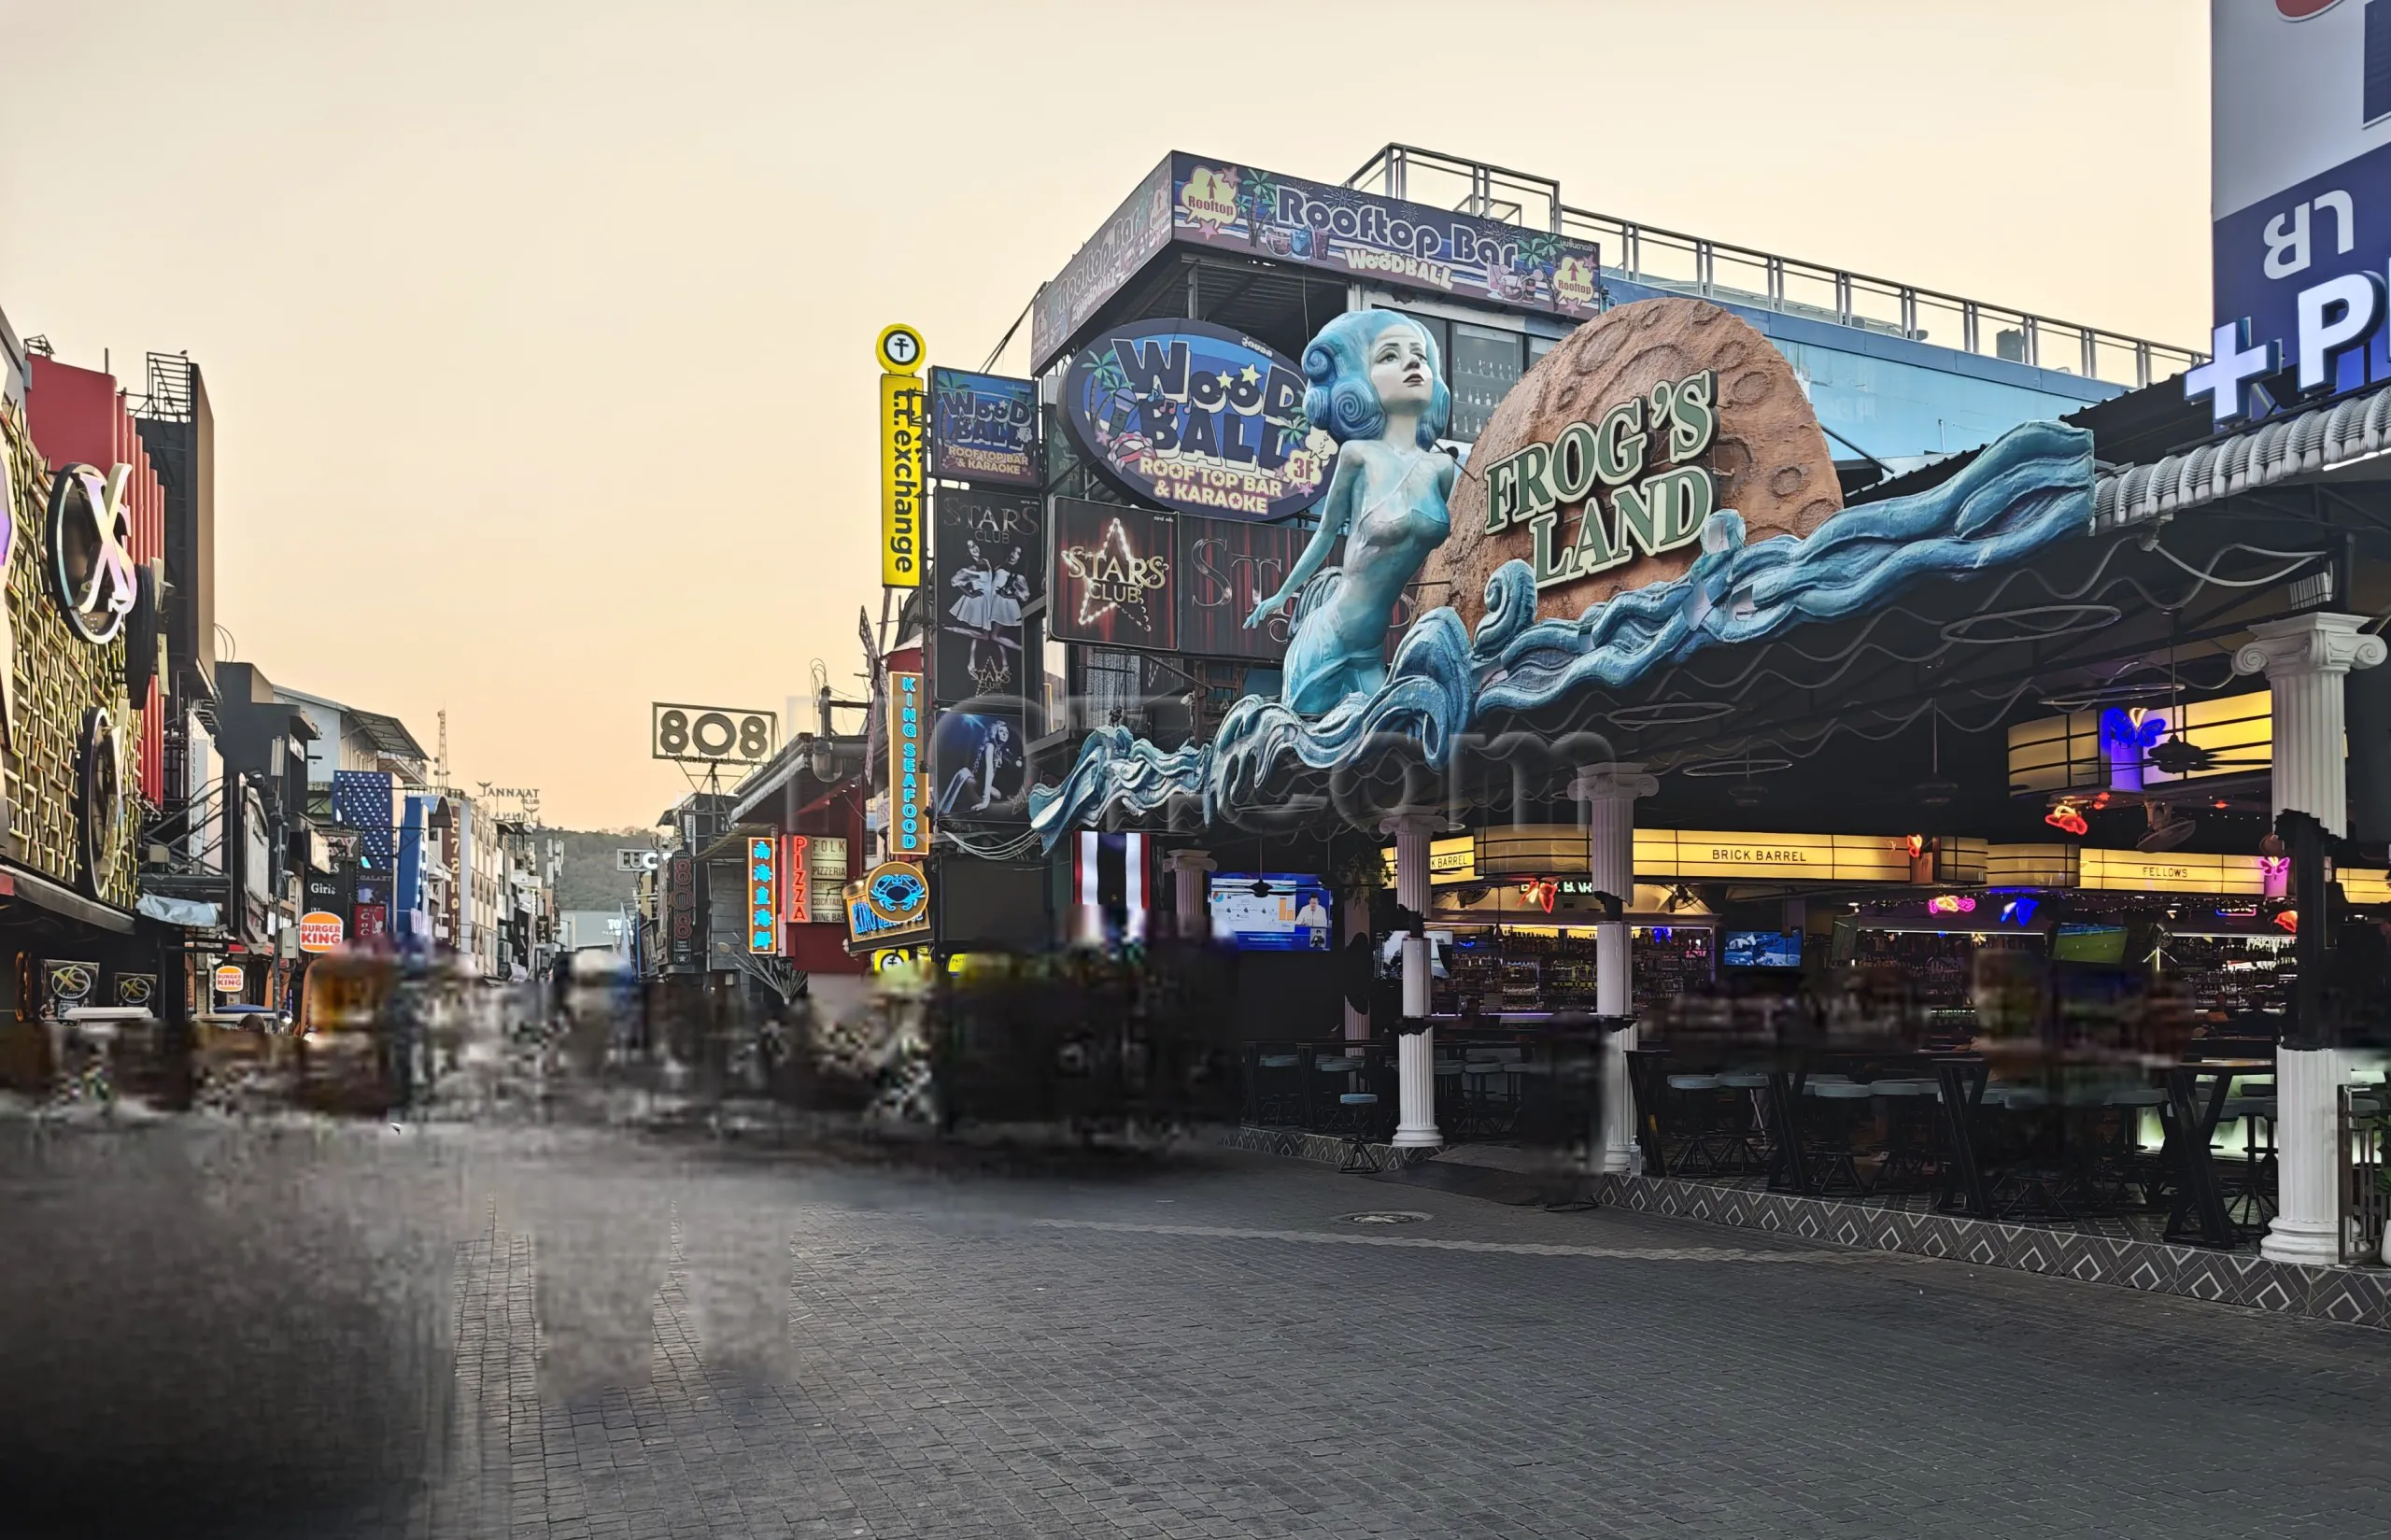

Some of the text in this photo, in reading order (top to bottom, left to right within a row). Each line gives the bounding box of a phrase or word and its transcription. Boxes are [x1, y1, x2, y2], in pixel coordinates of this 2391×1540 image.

[1188, 195, 1234, 217] Rooftop
[1276, 184, 1519, 272] Rooftop Bar
[1558, 279, 1592, 295] Rooftop
[955, 418, 1027, 452] BALL
[1138, 398, 1292, 478] BALL
[948, 446, 1028, 465] ROOF TOP BAR
[1484, 370, 1718, 535] FROG'S
[968, 460, 1021, 474] KARAOKE
[1140, 457, 1282, 497] ROOF TOP BAR
[1294, 458, 1313, 479] 3F
[1154, 479, 1268, 515] & KARAOKE
[943, 497, 1040, 535] STARS
[975, 530, 1011, 544] CLUB
[1530, 466, 1715, 588] LAND
[1068, 545, 1167, 589] STARS
[1088, 580, 1141, 603] CLUB
[969, 668, 1012, 683] STARS
[901, 676, 917, 850] KING SEAFOOD
[813, 841, 846, 853] FOLK
[1713, 849, 1807, 862] BRICK BARREL
[813, 866, 846, 877] PIZZERIA
[1437, 855, 1467, 868] BARREL
[792, 835, 808, 923] PIZZA
[2143, 867, 2188, 878] FELLOWS
[813, 912, 829, 922] WINE
[301, 933, 341, 944] KING
[50, 965, 88, 994] XS
[120, 977, 149, 998] XS
